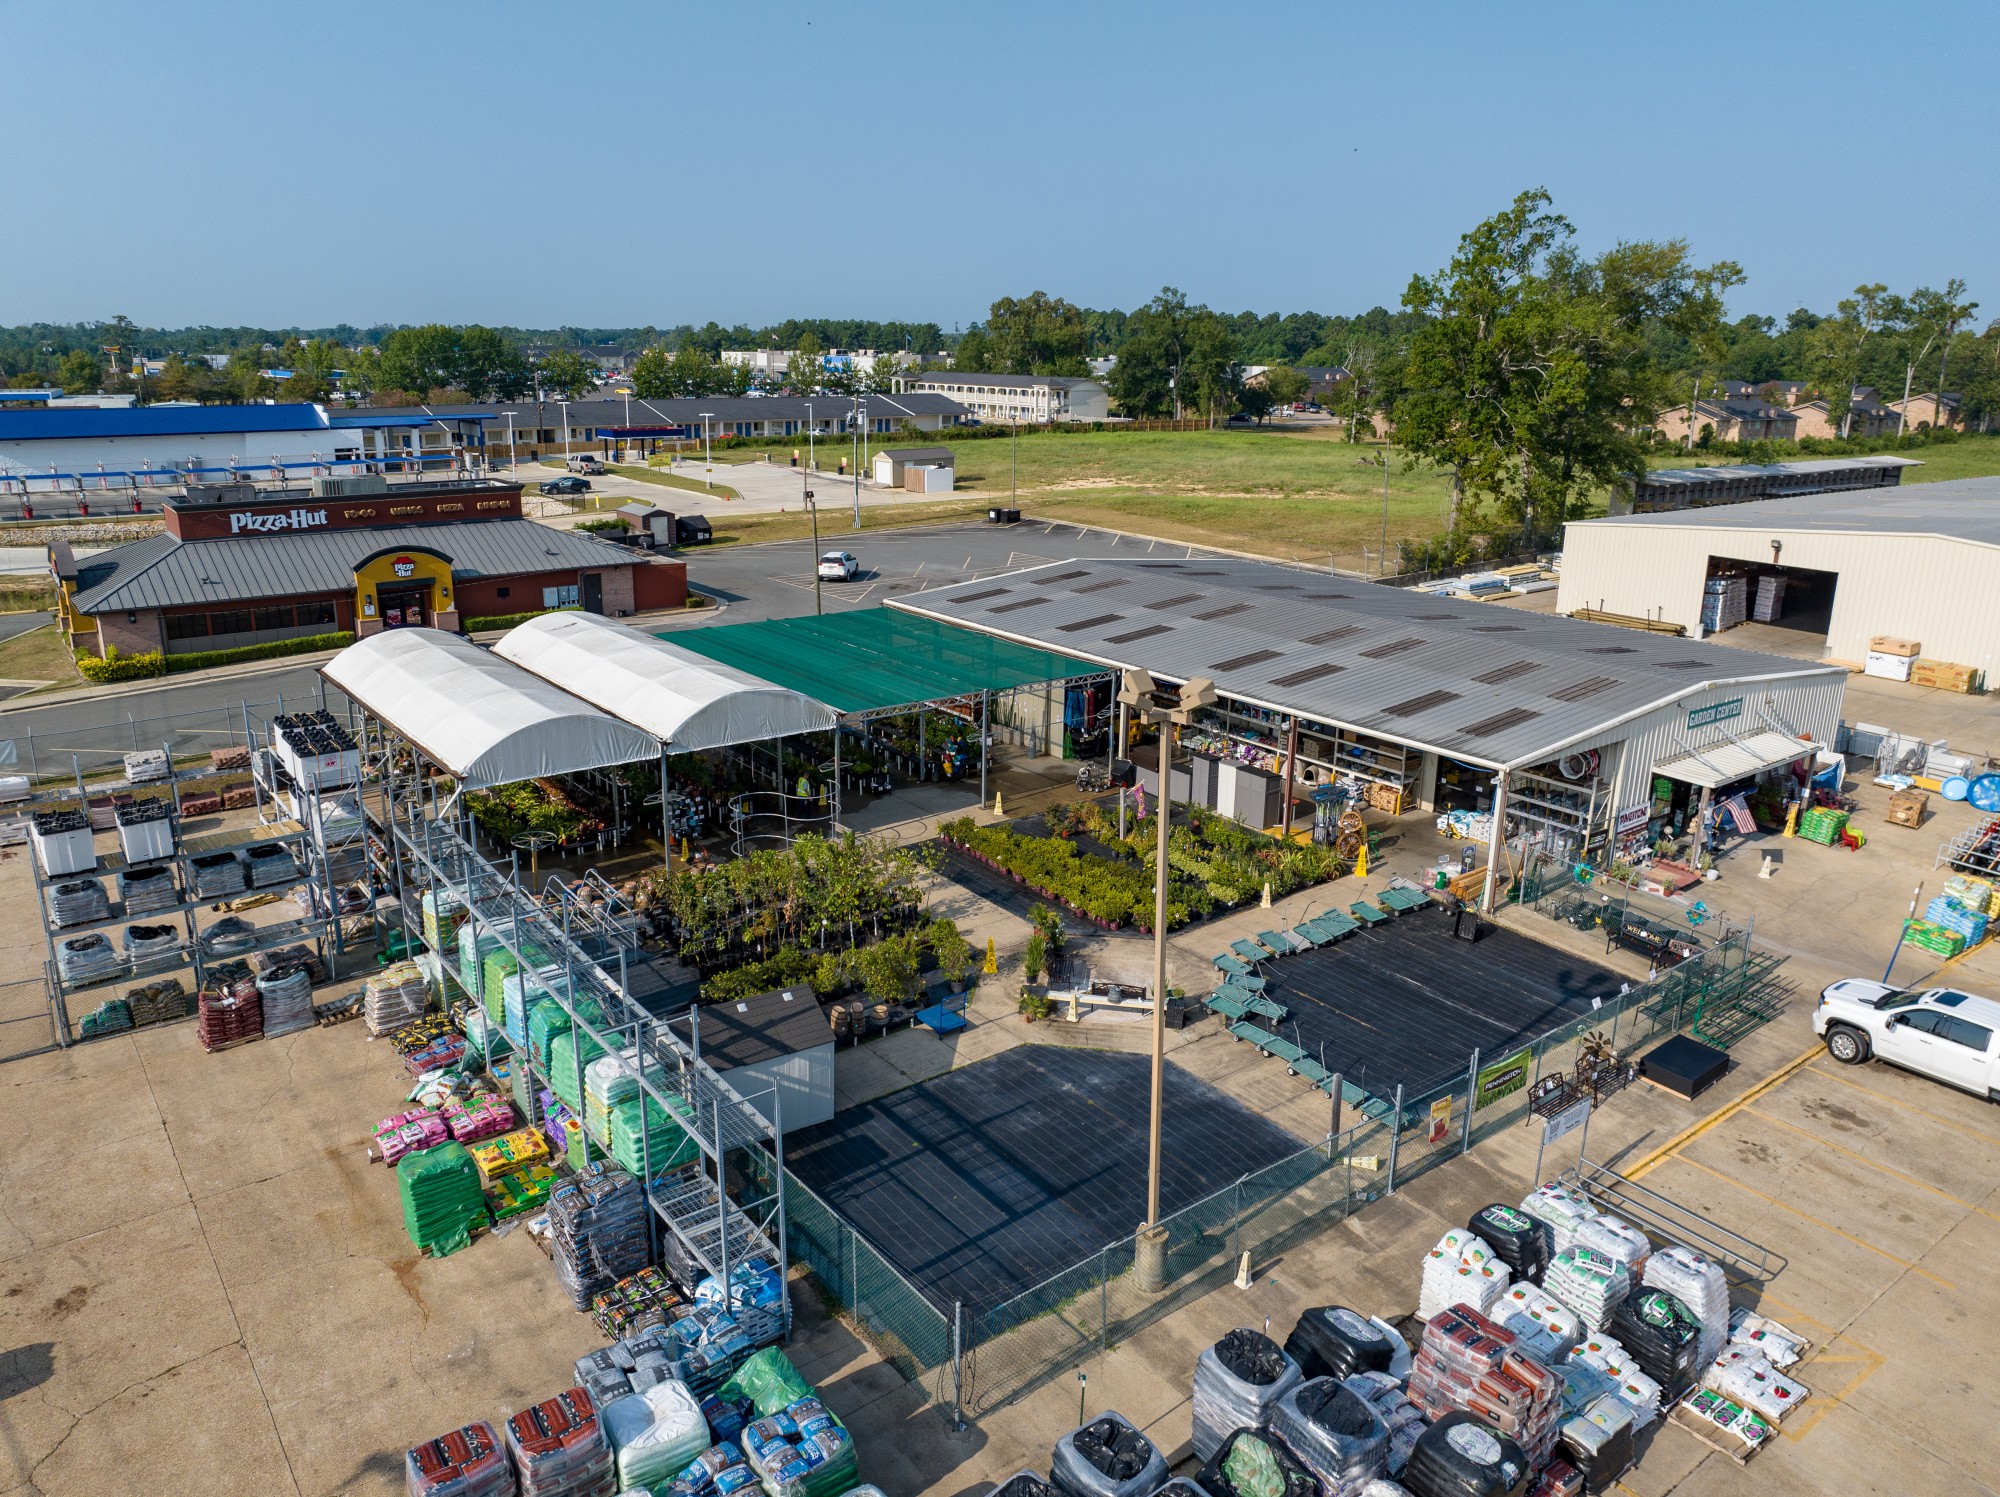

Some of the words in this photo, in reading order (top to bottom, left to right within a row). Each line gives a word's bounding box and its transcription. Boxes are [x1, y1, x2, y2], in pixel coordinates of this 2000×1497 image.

[389, 505, 424, 516] WINGS
[436, 502, 465, 513] PIZZA
[229, 512, 288, 533] Pizza
[287, 508, 328, 529] Hut
[394, 563, 415, 572] Pizza
[1688, 708, 1717, 727] GARDEN
[1716, 702, 1742, 719] CENTER
[1626, 924, 1662, 943] WELOME
[1484, 1067, 1523, 1091] PENNINGTON
